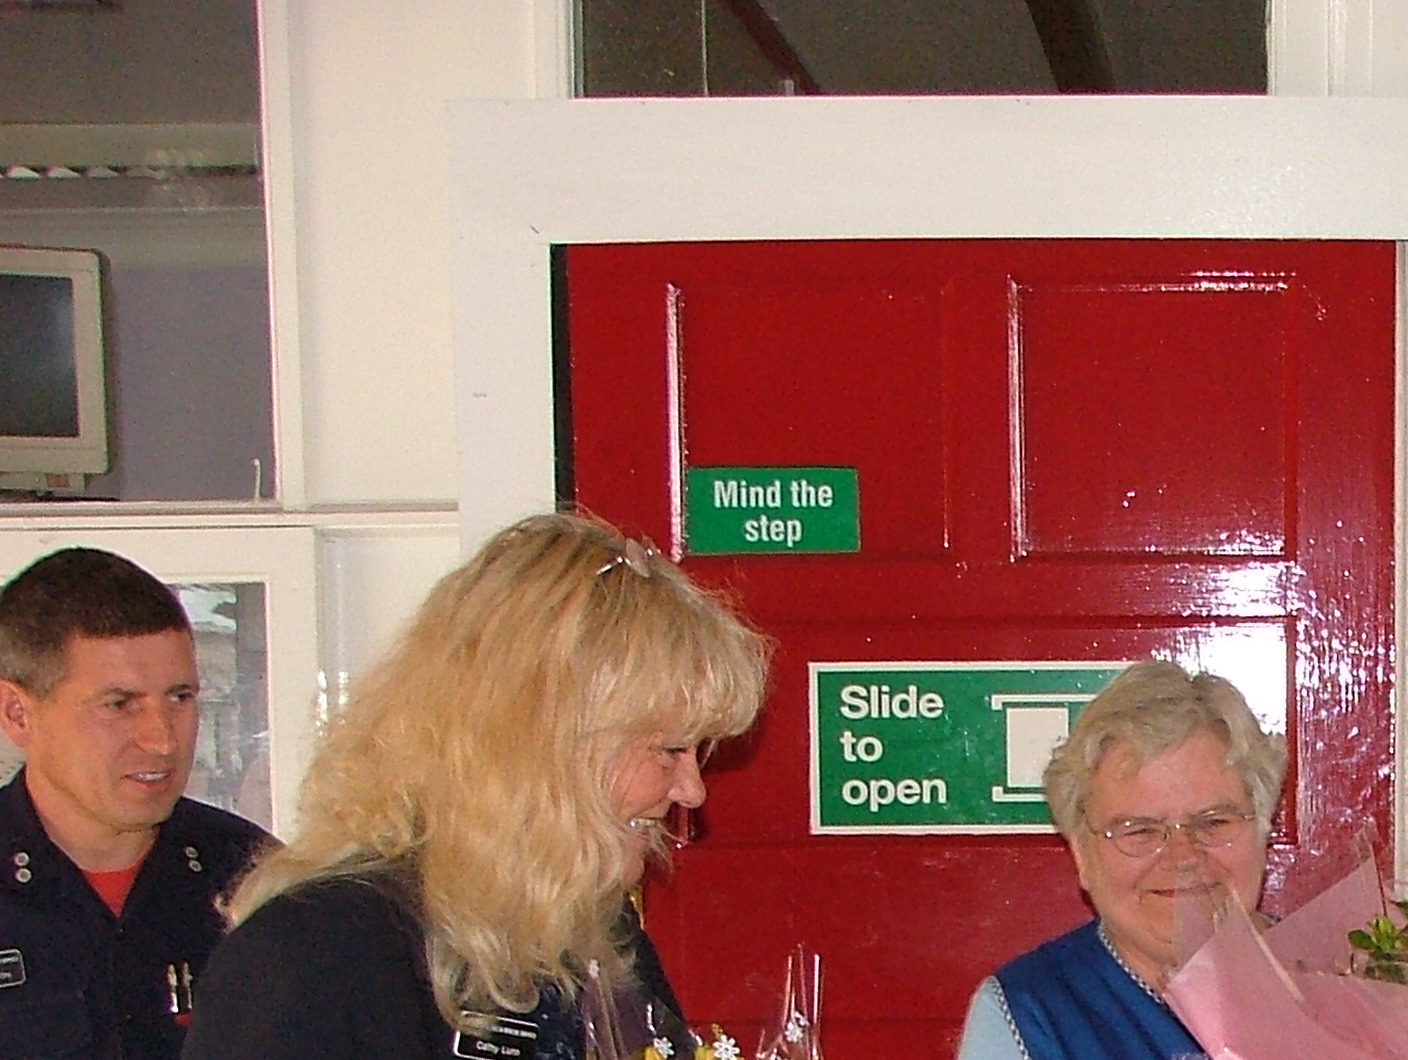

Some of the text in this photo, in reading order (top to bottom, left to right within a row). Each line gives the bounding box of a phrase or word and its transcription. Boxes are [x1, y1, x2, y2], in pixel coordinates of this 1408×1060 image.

[713, 479, 833, 508] Mind the
[744, 514, 802, 548] step
[840, 685, 944, 719] Slide
[839, 730, 883, 762] to
[842, 778, 947, 812] open
